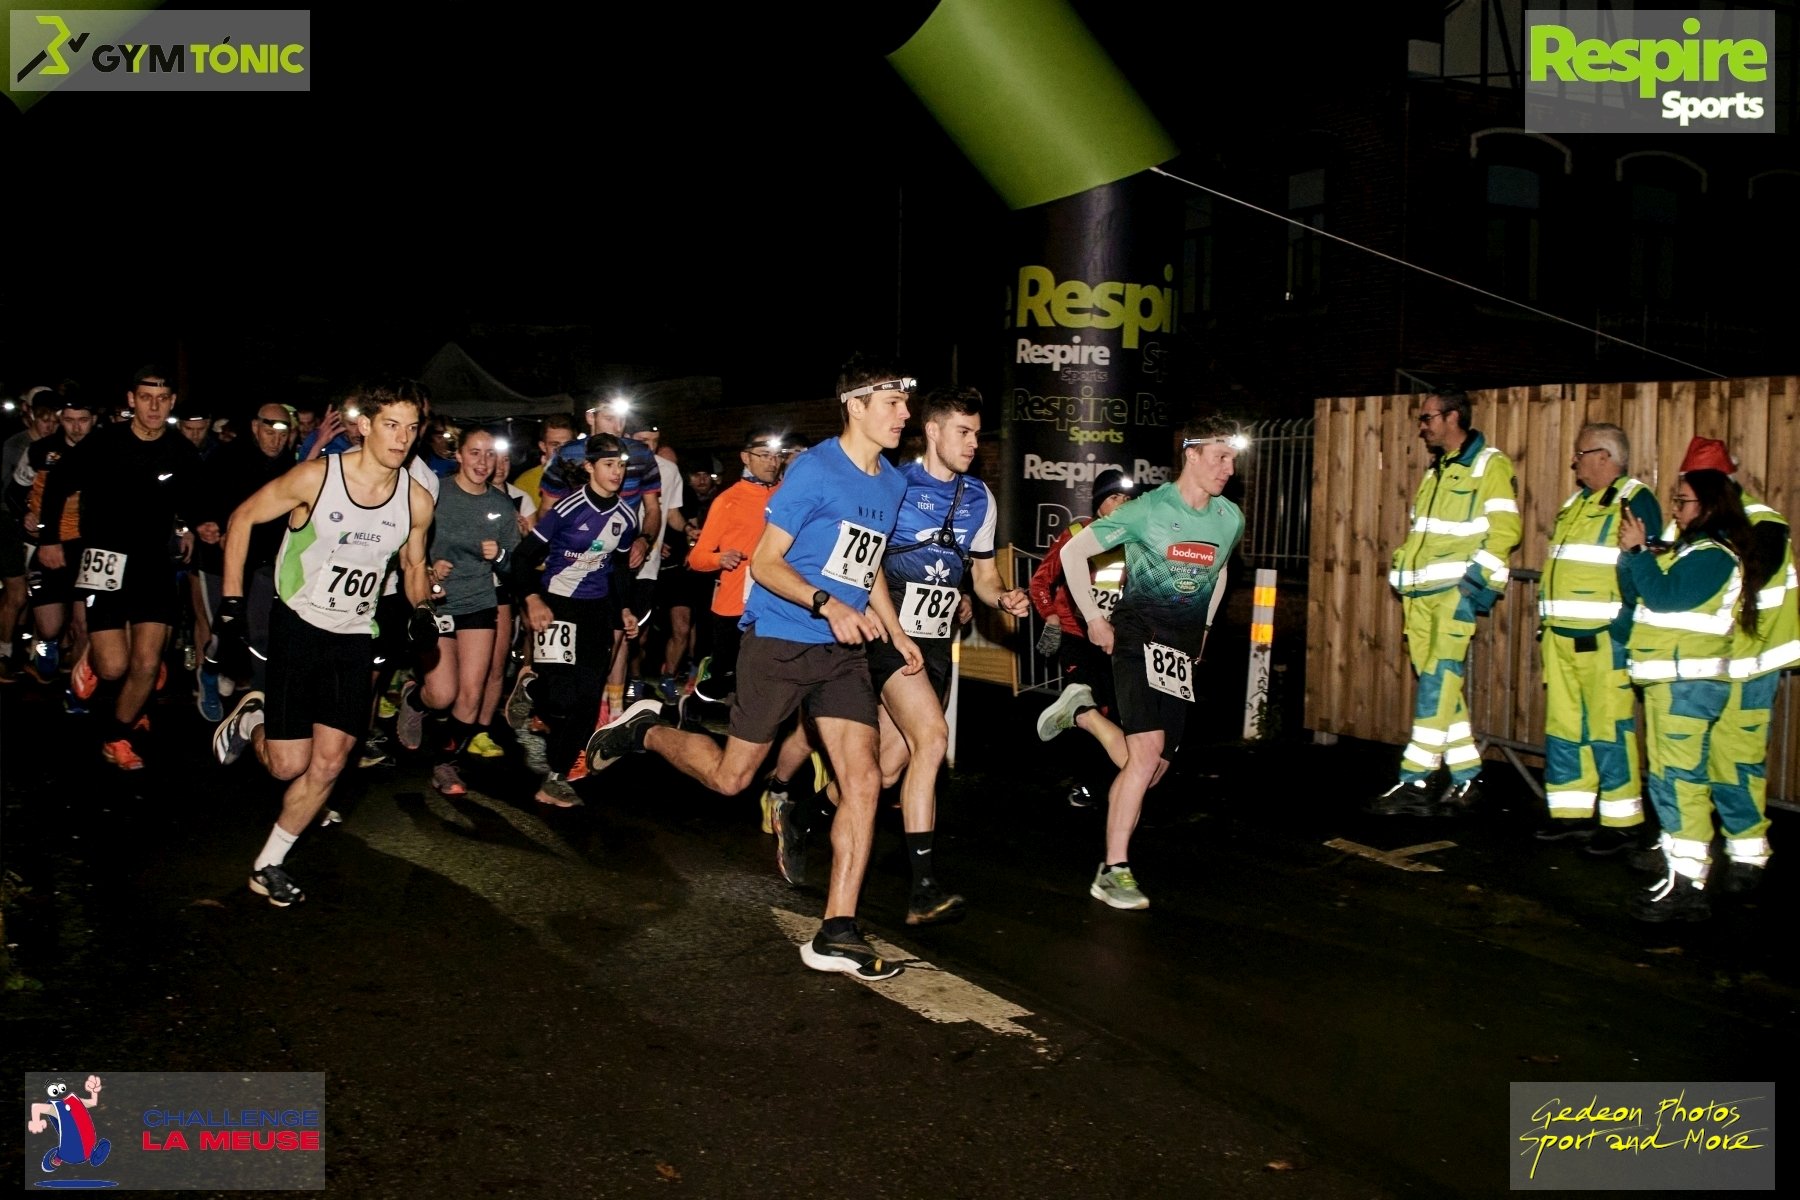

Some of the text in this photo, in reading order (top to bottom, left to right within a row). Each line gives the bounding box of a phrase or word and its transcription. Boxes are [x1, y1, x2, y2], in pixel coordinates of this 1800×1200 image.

[1016, 335, 1110, 371] Respire
[1061, 367, 1109, 384] Sports
[1012, 386, 1129, 431] Respire
[1069, 426, 1124, 445] Sports
[858, 506, 884, 522] NIKE
[353, 531, 382, 543] NELLES
[843, 527, 883, 566] 787
[83, 550, 117, 575] 958
[1172, 546, 1214, 561] bodarwé
[328, 565, 377, 598] 760
[913, 588, 956, 619] 782
[1153, 649, 1187, 682] 826
